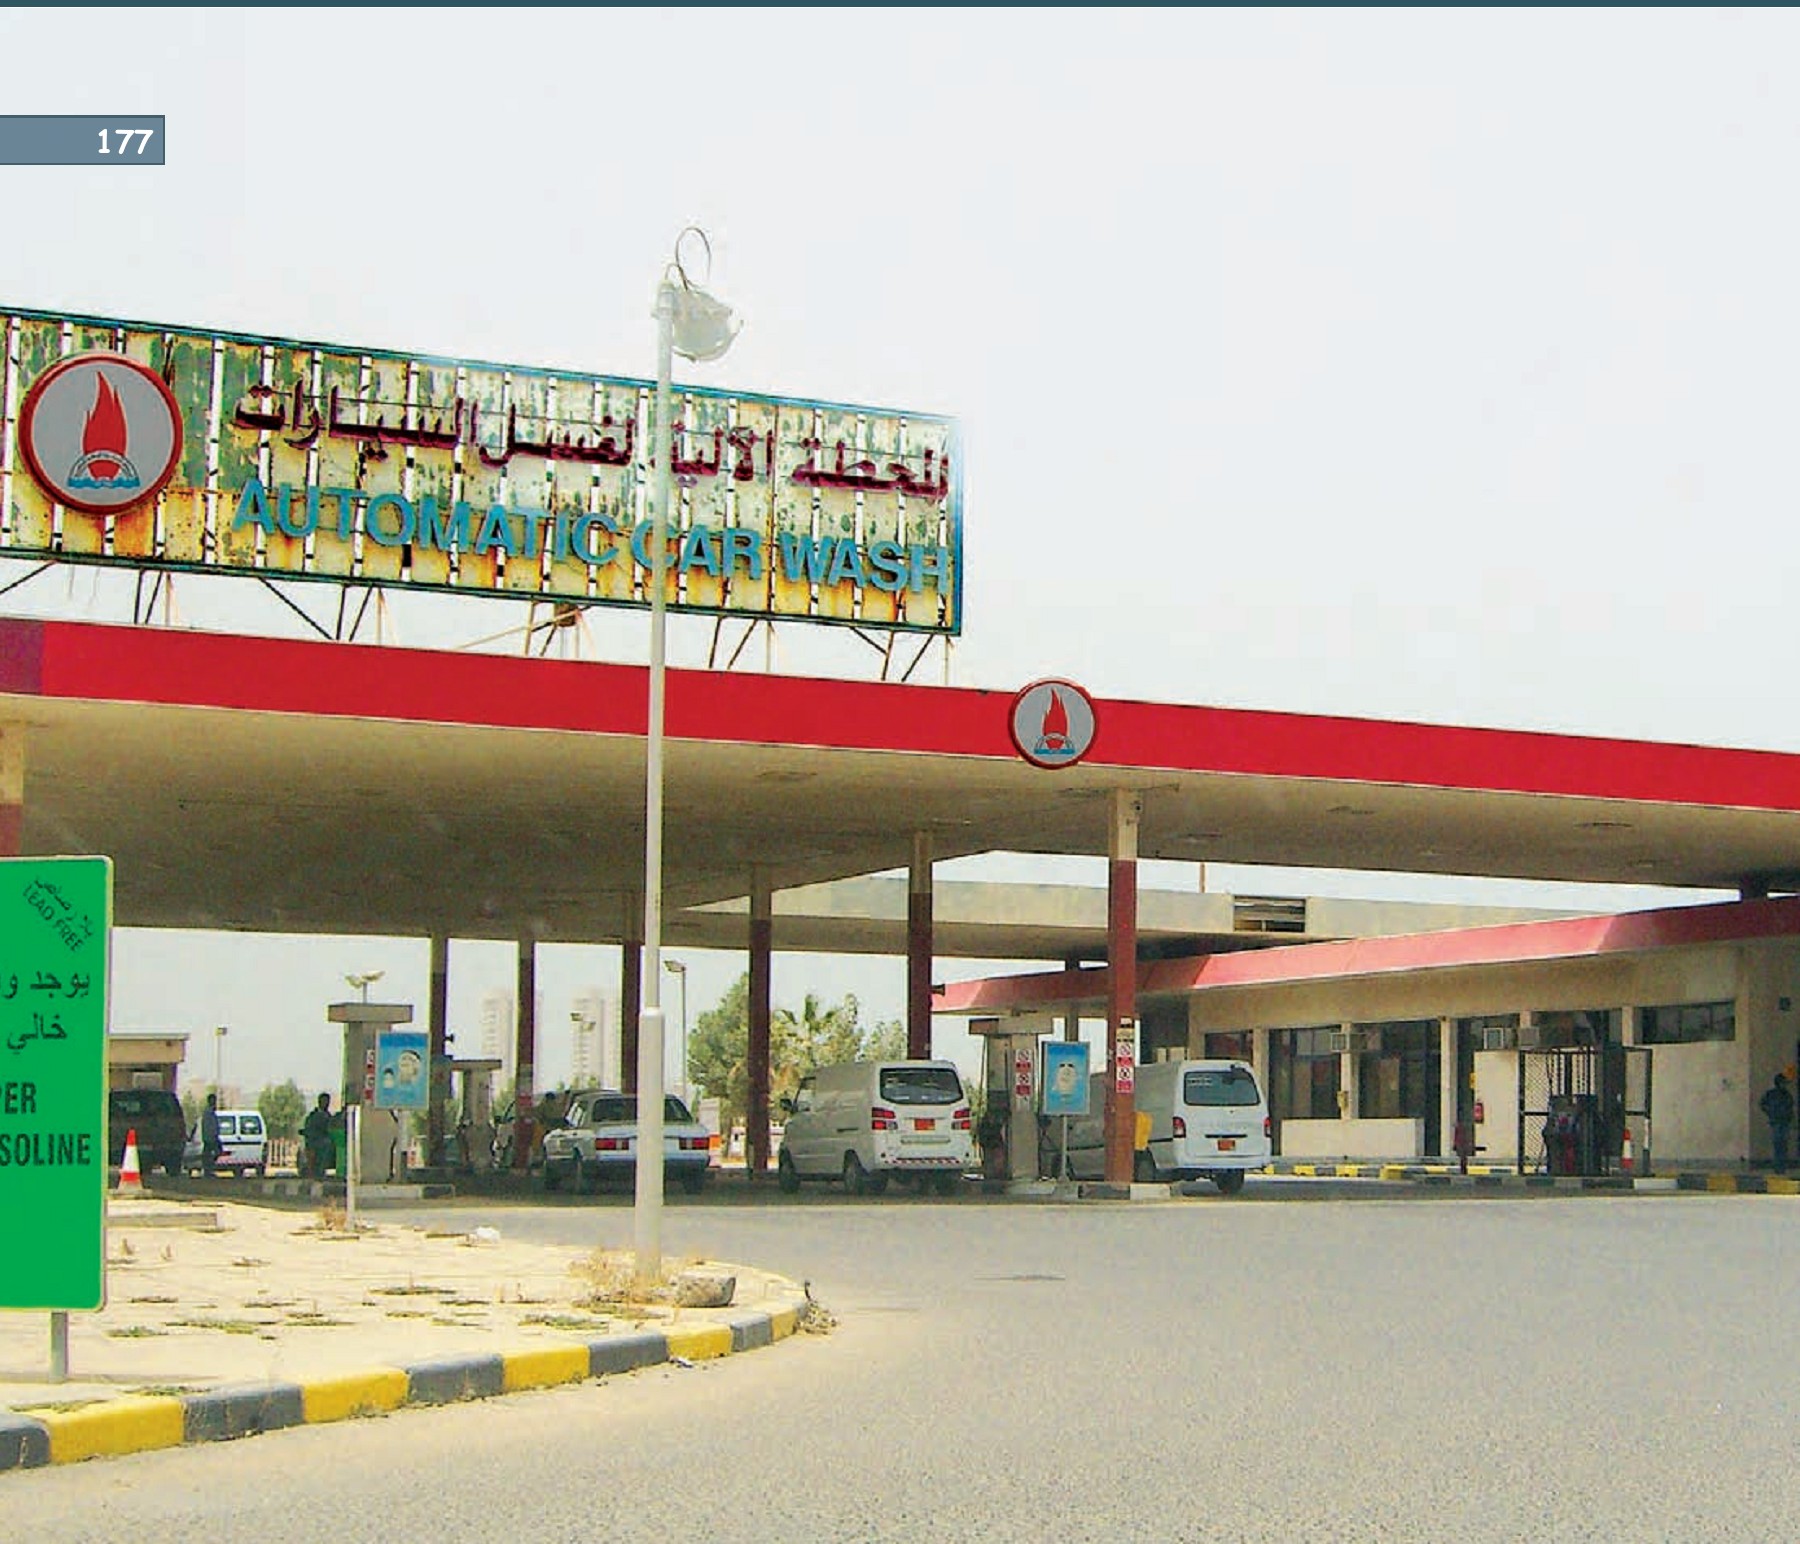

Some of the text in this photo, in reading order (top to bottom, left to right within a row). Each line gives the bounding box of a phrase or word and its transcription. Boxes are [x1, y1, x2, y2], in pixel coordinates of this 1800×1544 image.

[231, 477, 947, 595] AUTOMATIC CAR WASH
[22, 884, 85, 952] LEAD FREE
[0, 1082, 37, 1114] ER
